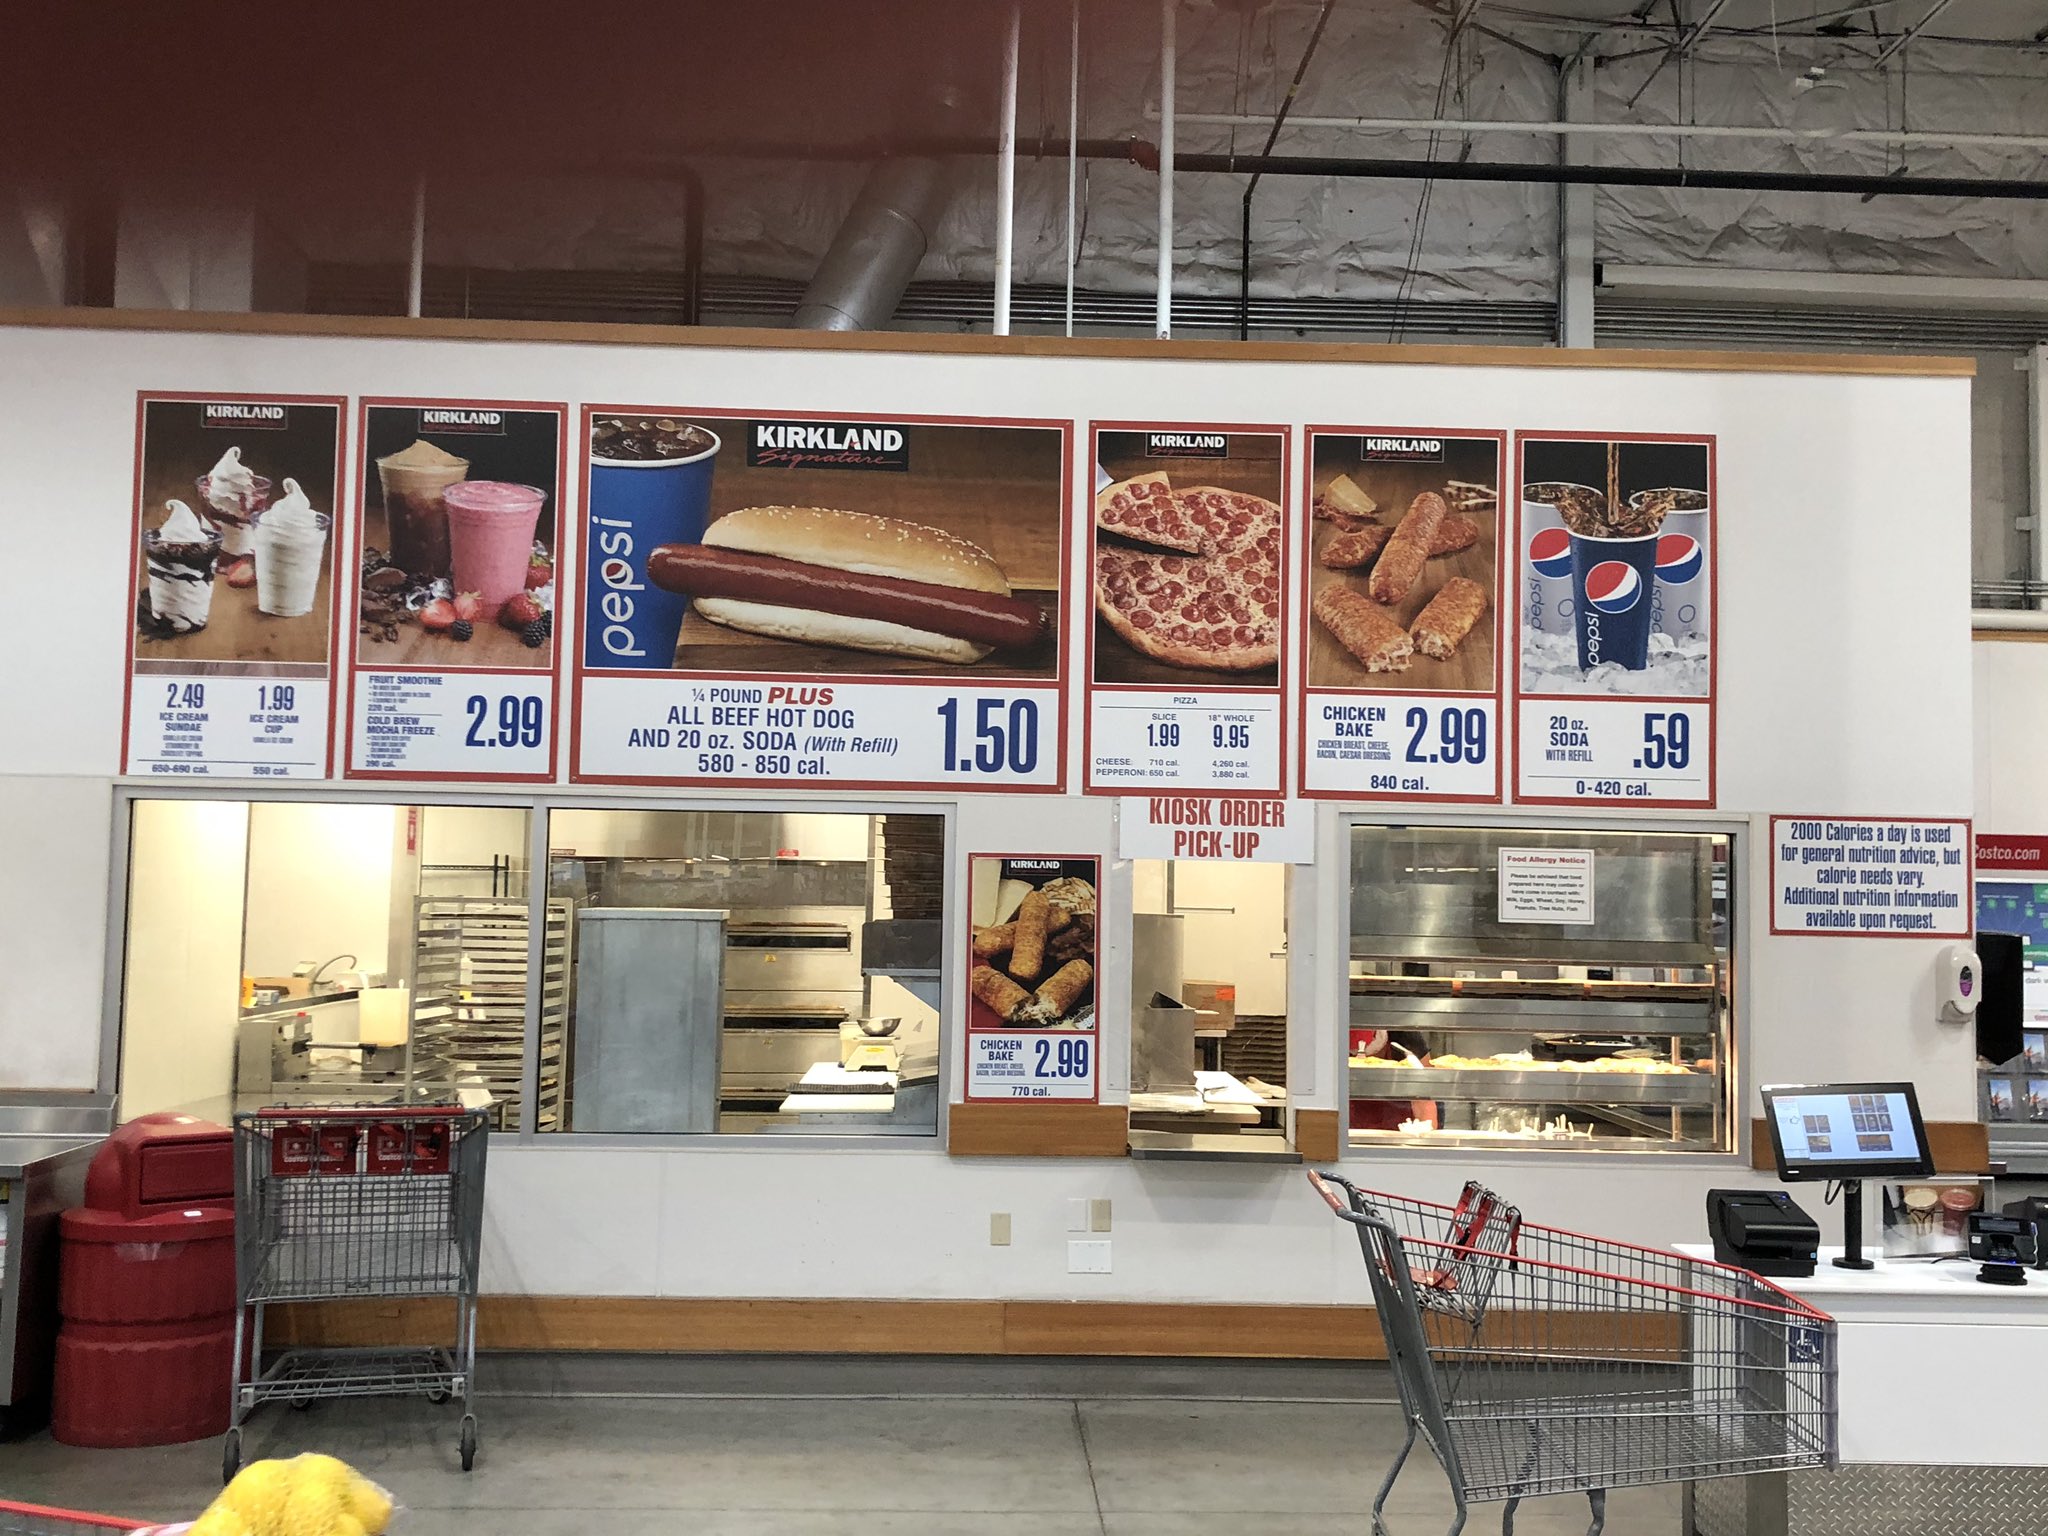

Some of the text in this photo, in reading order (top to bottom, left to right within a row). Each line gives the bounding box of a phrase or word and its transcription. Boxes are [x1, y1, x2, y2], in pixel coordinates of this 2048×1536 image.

[206, 405, 283, 419] KIRKLAND
[424, 410, 500, 425] KIRKLAND
[757, 426, 903, 451] KIRKLAND
[1150, 434, 1225, 448] KIRKLAND
[1366, 439, 1440, 453] KIRKLAND
[758, 448, 902, 469] Signature
[592, 515, 646, 657] pepsi
[1528, 577, 1545, 631] pepsi
[1585, 612, 1604, 666] pepsi
[369, 676, 443, 685] FRUIT SMOOTHIE
[167, 683, 204, 708] 2.49
[258, 685, 294, 710] 1.99
[710, 689, 762, 705] POUND
[768, 687, 834, 706] PLUS
[159, 712, 208, 722] ICE CREAM
[250, 714, 299, 724] ICE CREAM
[367, 716, 420, 725] COLD BREW
[466, 694, 543, 748] 2.99
[667, 706, 854, 729] ALL BEEF HOT DOG
[1152, 713, 1177, 721] SLICE
[1323, 706, 1386, 721] CHICKEN
[165, 723, 202, 731] SUNDAE
[265, 725, 283, 734] CUP
[367, 726, 435, 735] MOCHA FREEZE
[1335, 723, 1373, 737] BAKE
[1550, 716, 1588, 731] 20 oz.
[628, 729, 898, 756] AND 20 oz. SODA (With Refill)
[937, 698, 1038, 774] 1.50
[1147, 723, 1180, 747] 1.99
[1213, 724, 1249, 748] 9.95
[1405, 707, 1487, 764] 2.99
[1550, 732, 1589, 747] SODA
[1633, 713, 1690, 769] .59
[1150, 758, 1163, 766] 710
[1545, 749, 1593, 762] WITH REFILL
[253, 766, 289, 775] 550 cal.
[698, 755, 734, 774] 580
[755, 755, 790, 775] 850
[797, 756, 830, 775] cal.
[1212, 760, 1234, 768] 4,260
[1149, 769, 1163, 777] 650
[1371, 775, 1429, 790] 840 cal.
[1626, 782, 1652, 796] cal.
[1150, 798, 1285, 827] KIOSK ORDER
[1791, 823, 1951, 845] 2000 Calories a day is used
[1174, 830, 1260, 858] PICK-UP
[1529, 856, 1557, 864] Allergy
[1781, 844, 1961, 867] for general nutrition advice, but
[1010, 861, 1060, 869] KIRKLAND
[1817, 867, 1925, 888] calorie needs vary.
[1784, 887, 1958, 908] Additional nutrition information
[1806, 910, 1936, 931] available upon request.
[980, 1040, 1022, 1050] CHICKEN
[988, 1051, 1014, 1061] BAKE
[1035, 1039, 1089, 1078] 2.99
[1012, 1086, 1051, 1097] 770 cal.
